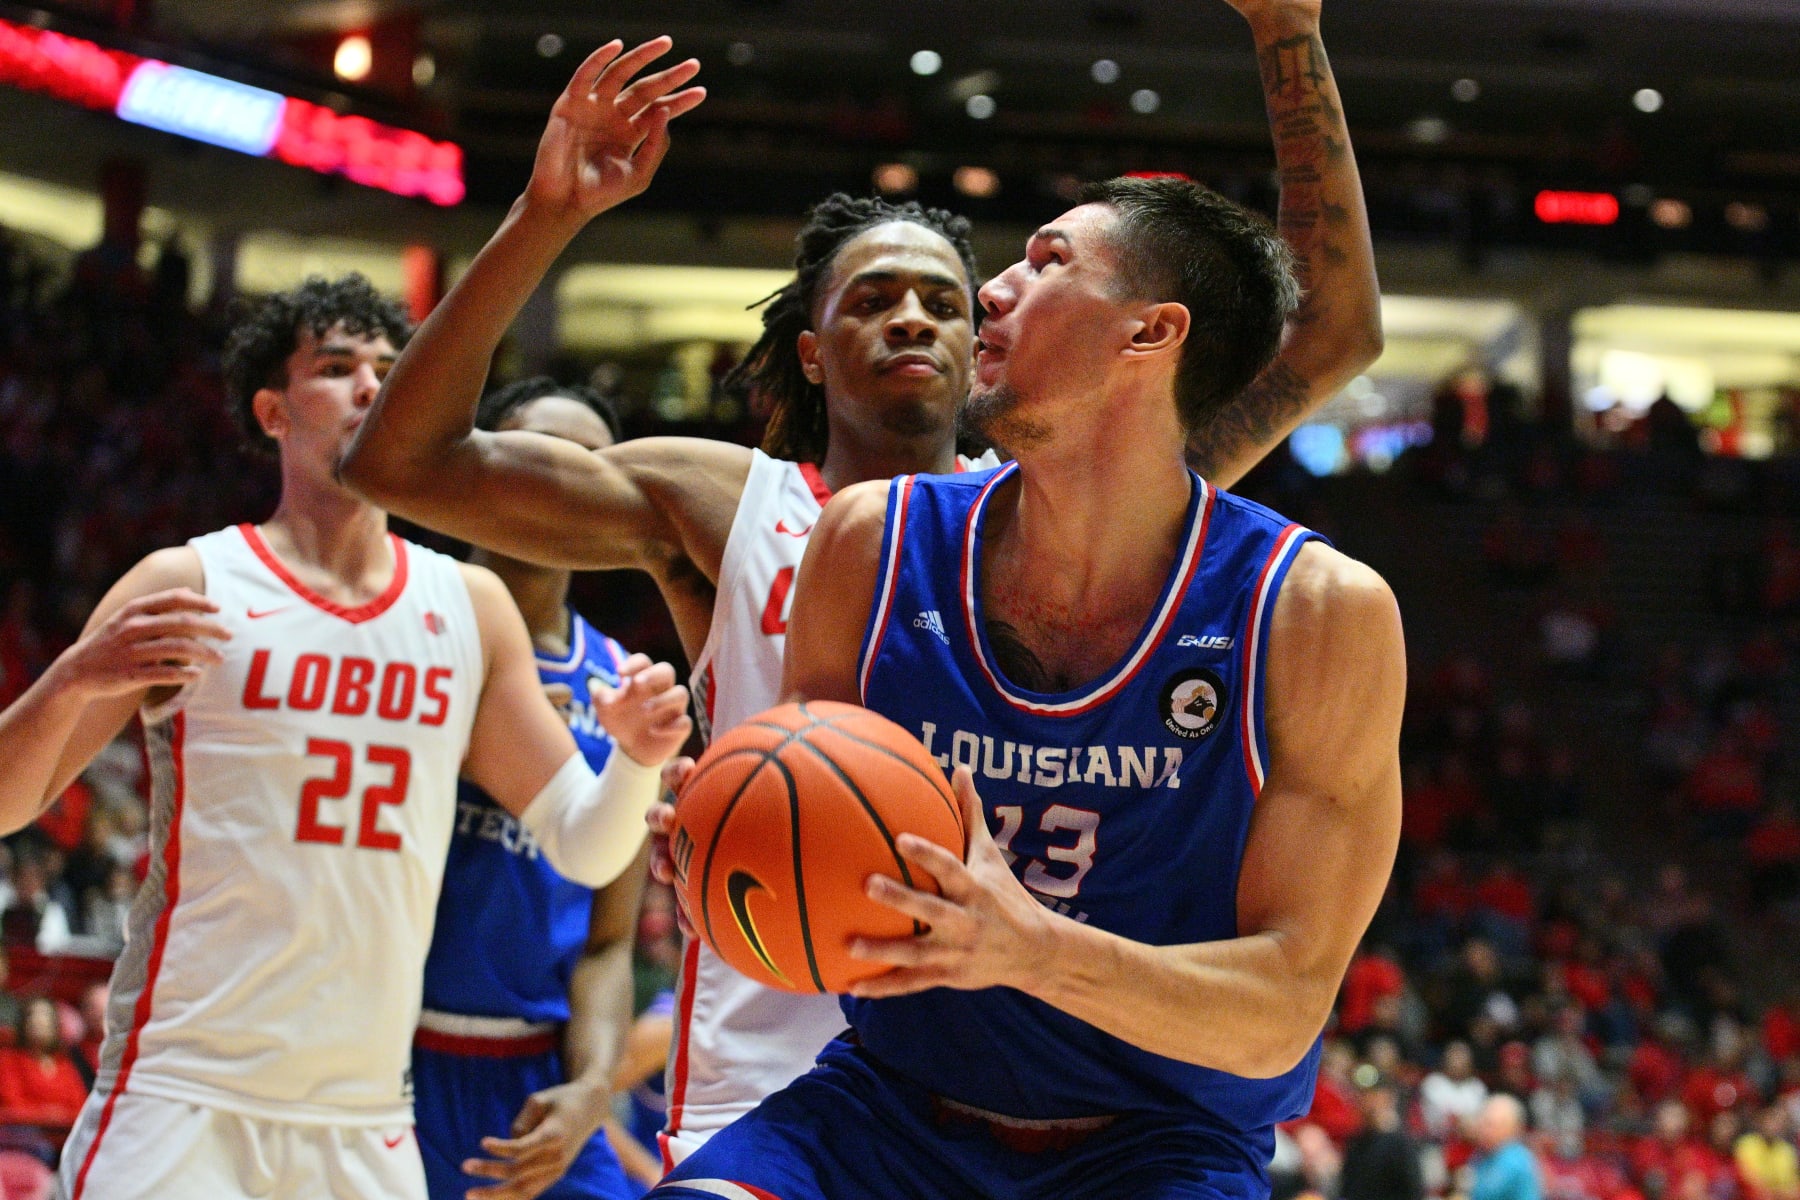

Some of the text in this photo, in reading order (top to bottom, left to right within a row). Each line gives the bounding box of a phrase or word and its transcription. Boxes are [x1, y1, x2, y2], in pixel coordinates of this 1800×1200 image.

[913, 618, 950, 646] adidas
[242, 649, 454, 727] LOBOS
[921, 720, 1184, 789] LOUISIANA
[1165, 718, 1214, 738] United As One
[295, 736, 412, 852] 22
[457, 801, 538, 859] TECH
[993, 803, 1101, 899] 13
